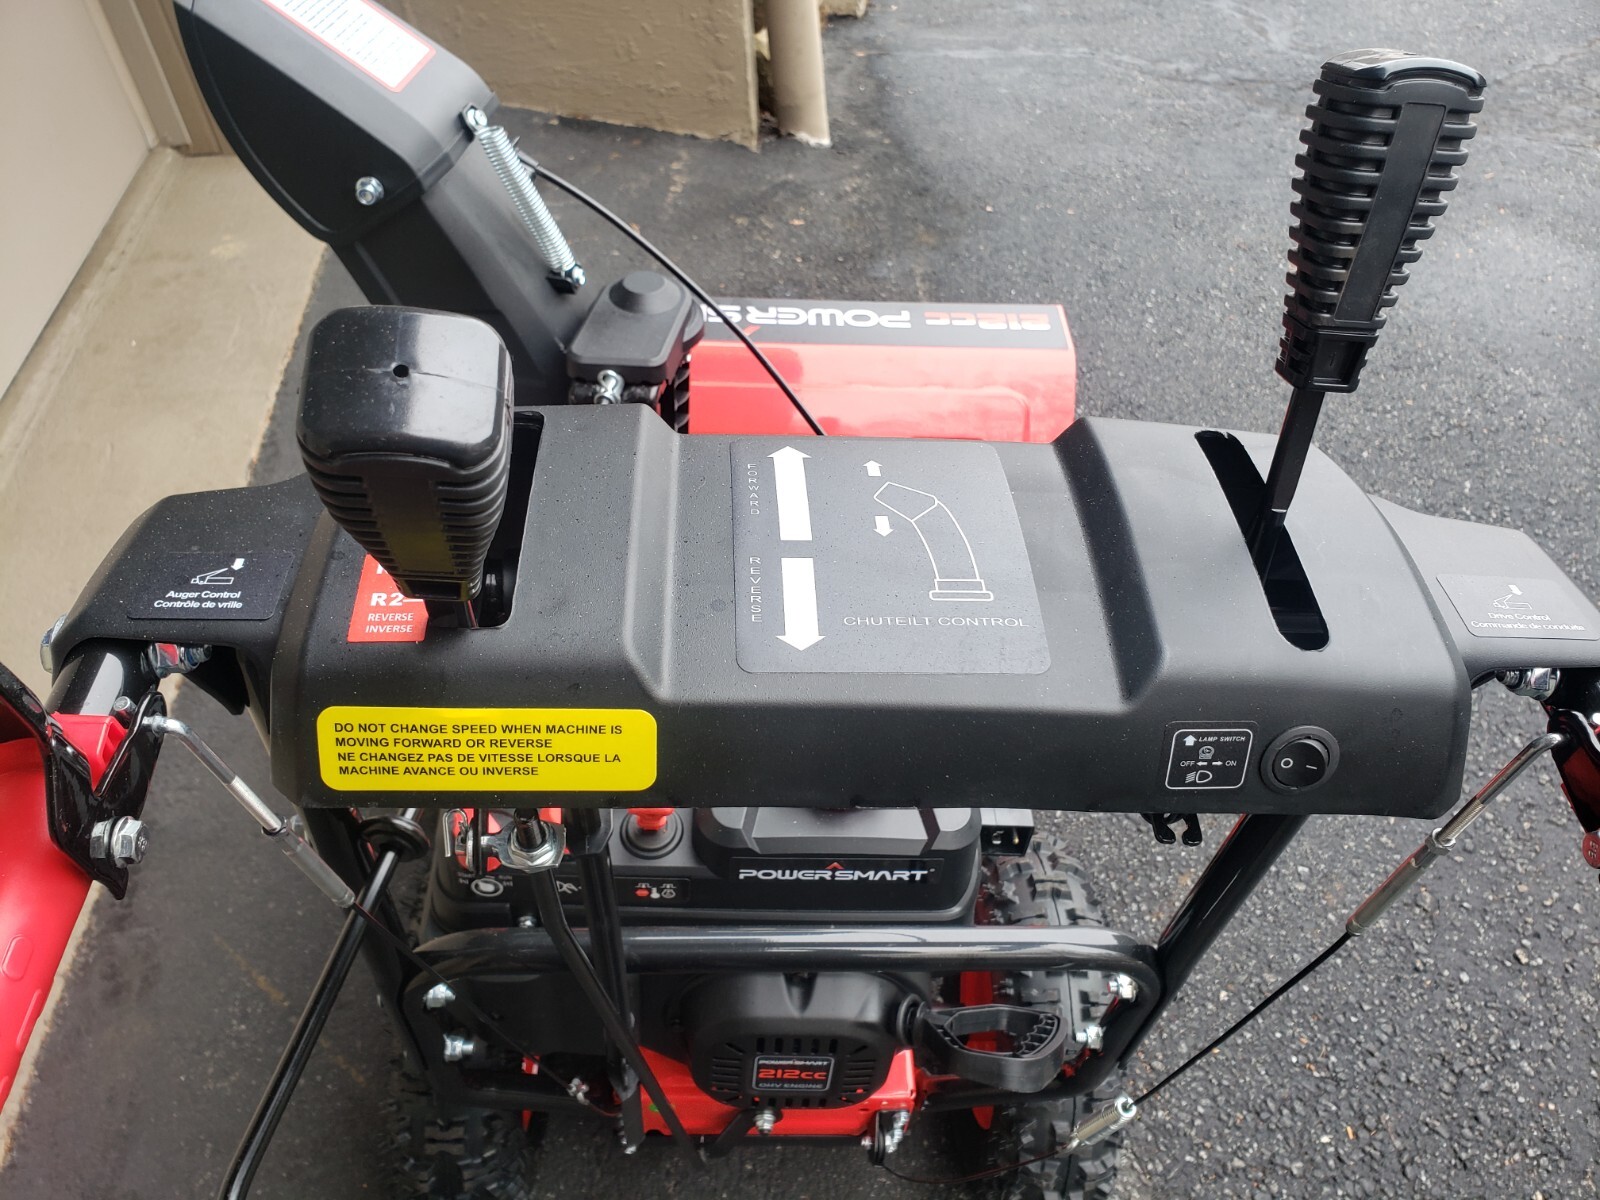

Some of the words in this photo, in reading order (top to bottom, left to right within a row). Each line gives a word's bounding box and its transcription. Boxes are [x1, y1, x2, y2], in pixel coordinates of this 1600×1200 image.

[924, 311, 1051, 331] 212cc
[747, 463, 761, 515] FORWARD
[165, 590, 200, 600] Auger
[201, 590, 242, 599] Control
[749, 556, 763, 623] REVERSE
[153, 600, 201, 608] Contrôle
[218, 601, 243, 609] vrille
[370, 592, 404, 607] R2
[367, 612, 415, 621] REVERSE
[843, 616, 933, 626] CHUTEILT
[938, 617, 1030, 627] CONTROL
[1487, 612, 1514, 620] Drive
[1514, 613, 1552, 621] Control
[365, 624, 413, 633] INVERSE
[1470, 620, 1528, 629] Commande
[1543, 623, 1586, 631] conduite
[334, 722, 354, 733] DO
[358, 723, 386, 733] NOT
[390, 723, 448, 734] CHANGE
[452, 724, 497, 734] SPEED
[501, 724, 541, 734] WHEN
[546, 724, 606, 735] MACHINE
[610, 725, 623, 735] IS
[335, 737, 389, 747] MOVING
[393, 738, 462, 748] FORWARD
[465, 738, 486, 748] OR
[489, 738, 553, 748] REVERSE
[337, 752, 356, 762] NE
[359, 752, 424, 762] CHANGEZ
[428, 753, 453, 763] PAS
[457, 753, 475, 763] DE
[479, 753, 533, 763] VITESSE
[537, 753, 601, 764] LORSQUE
[604, 753, 621, 763] LA
[339, 766, 400, 775] MACHINE
[403, 766, 455, 776] AVANCE
[459, 766, 479, 776] OU
[482, 766, 539, 776] INVERSE
[758, 1068, 827, 1080] 212cc
